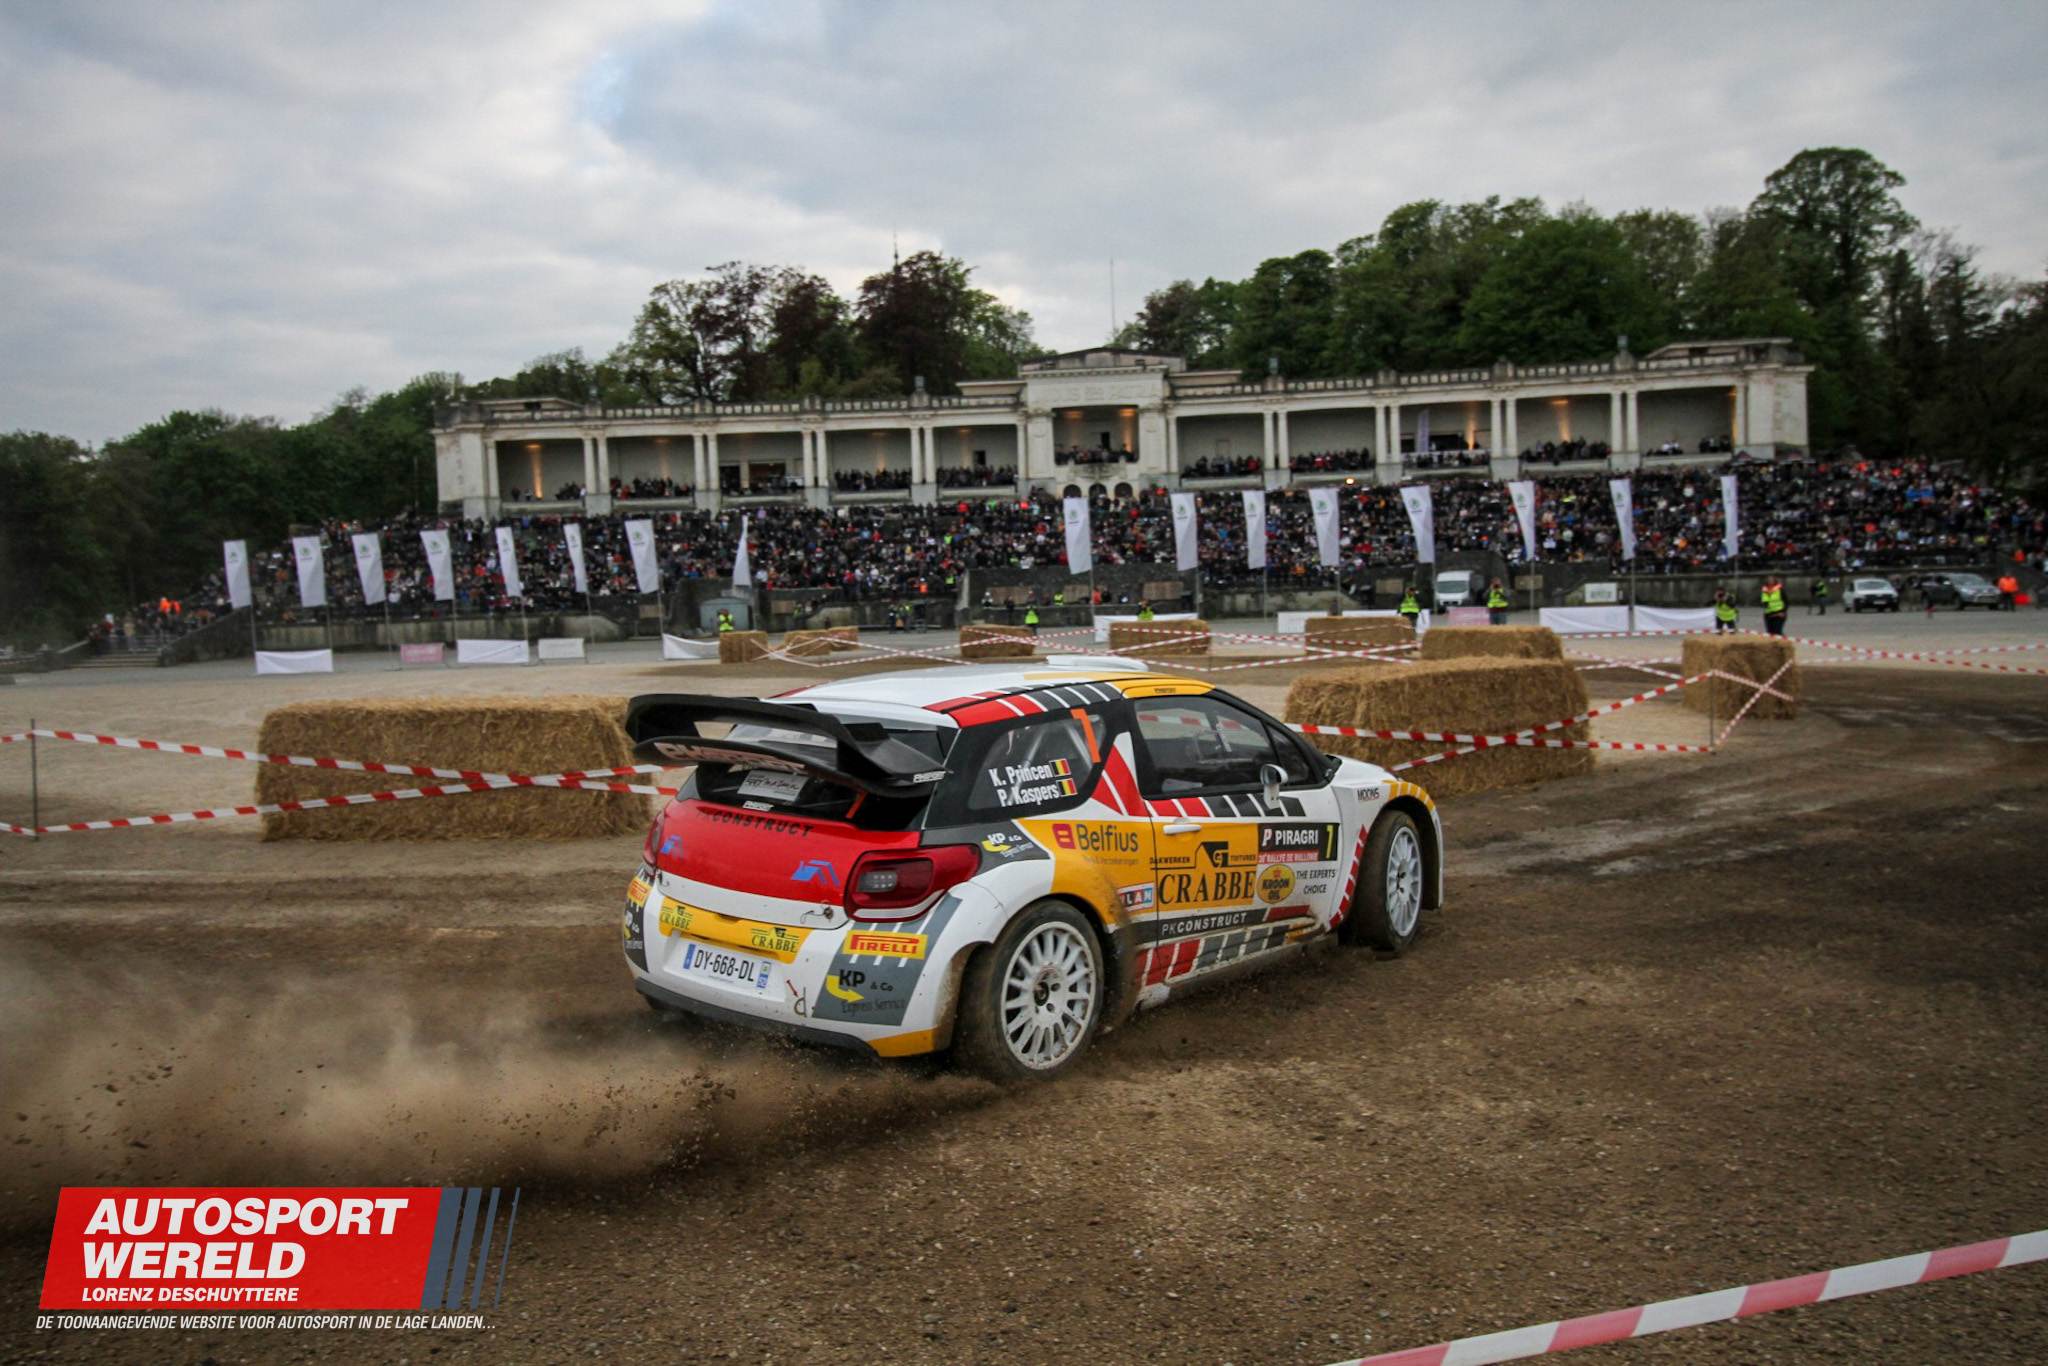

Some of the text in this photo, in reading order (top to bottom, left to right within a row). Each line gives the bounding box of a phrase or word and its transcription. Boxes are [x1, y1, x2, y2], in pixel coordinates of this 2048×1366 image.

[988, 765, 1054, 787] K. Princen
[997, 784, 1060, 807] P. Kaspers
[1076, 823, 1139, 852] Belfius
[1275, 829, 1319, 846] PIRAGRI
[1159, 871, 1256, 905] CRABBE
[1161, 912, 1247, 936] PKCONSTRUCT
[751, 934, 798, 953] CRABBE
[850, 934, 920, 954] PIRELLI
[694, 949, 754, 982] DY-668-DL
[839, 969, 865, 987] KP
